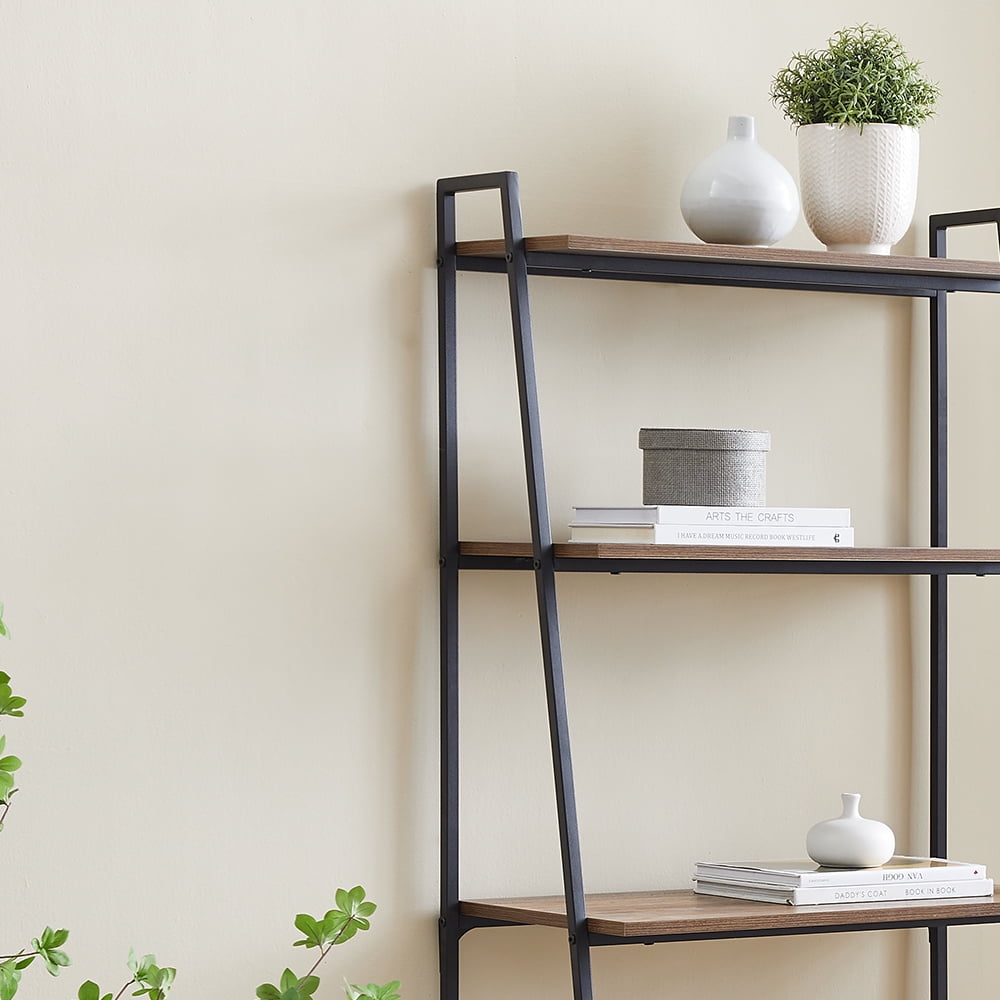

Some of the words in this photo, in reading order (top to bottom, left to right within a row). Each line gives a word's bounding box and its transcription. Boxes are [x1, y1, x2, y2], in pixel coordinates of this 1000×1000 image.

[705, 511, 731, 521] ARTS
[735, 512, 753, 521] THE
[757, 512, 795, 522] CRAFTS
[882, 873, 904, 881] GOGH
[907, 872, 923, 880] VAN
[868, 889, 888, 898] COAT
[905, 888, 926, 896] BOOK
[936, 886, 957, 894] BOOK
